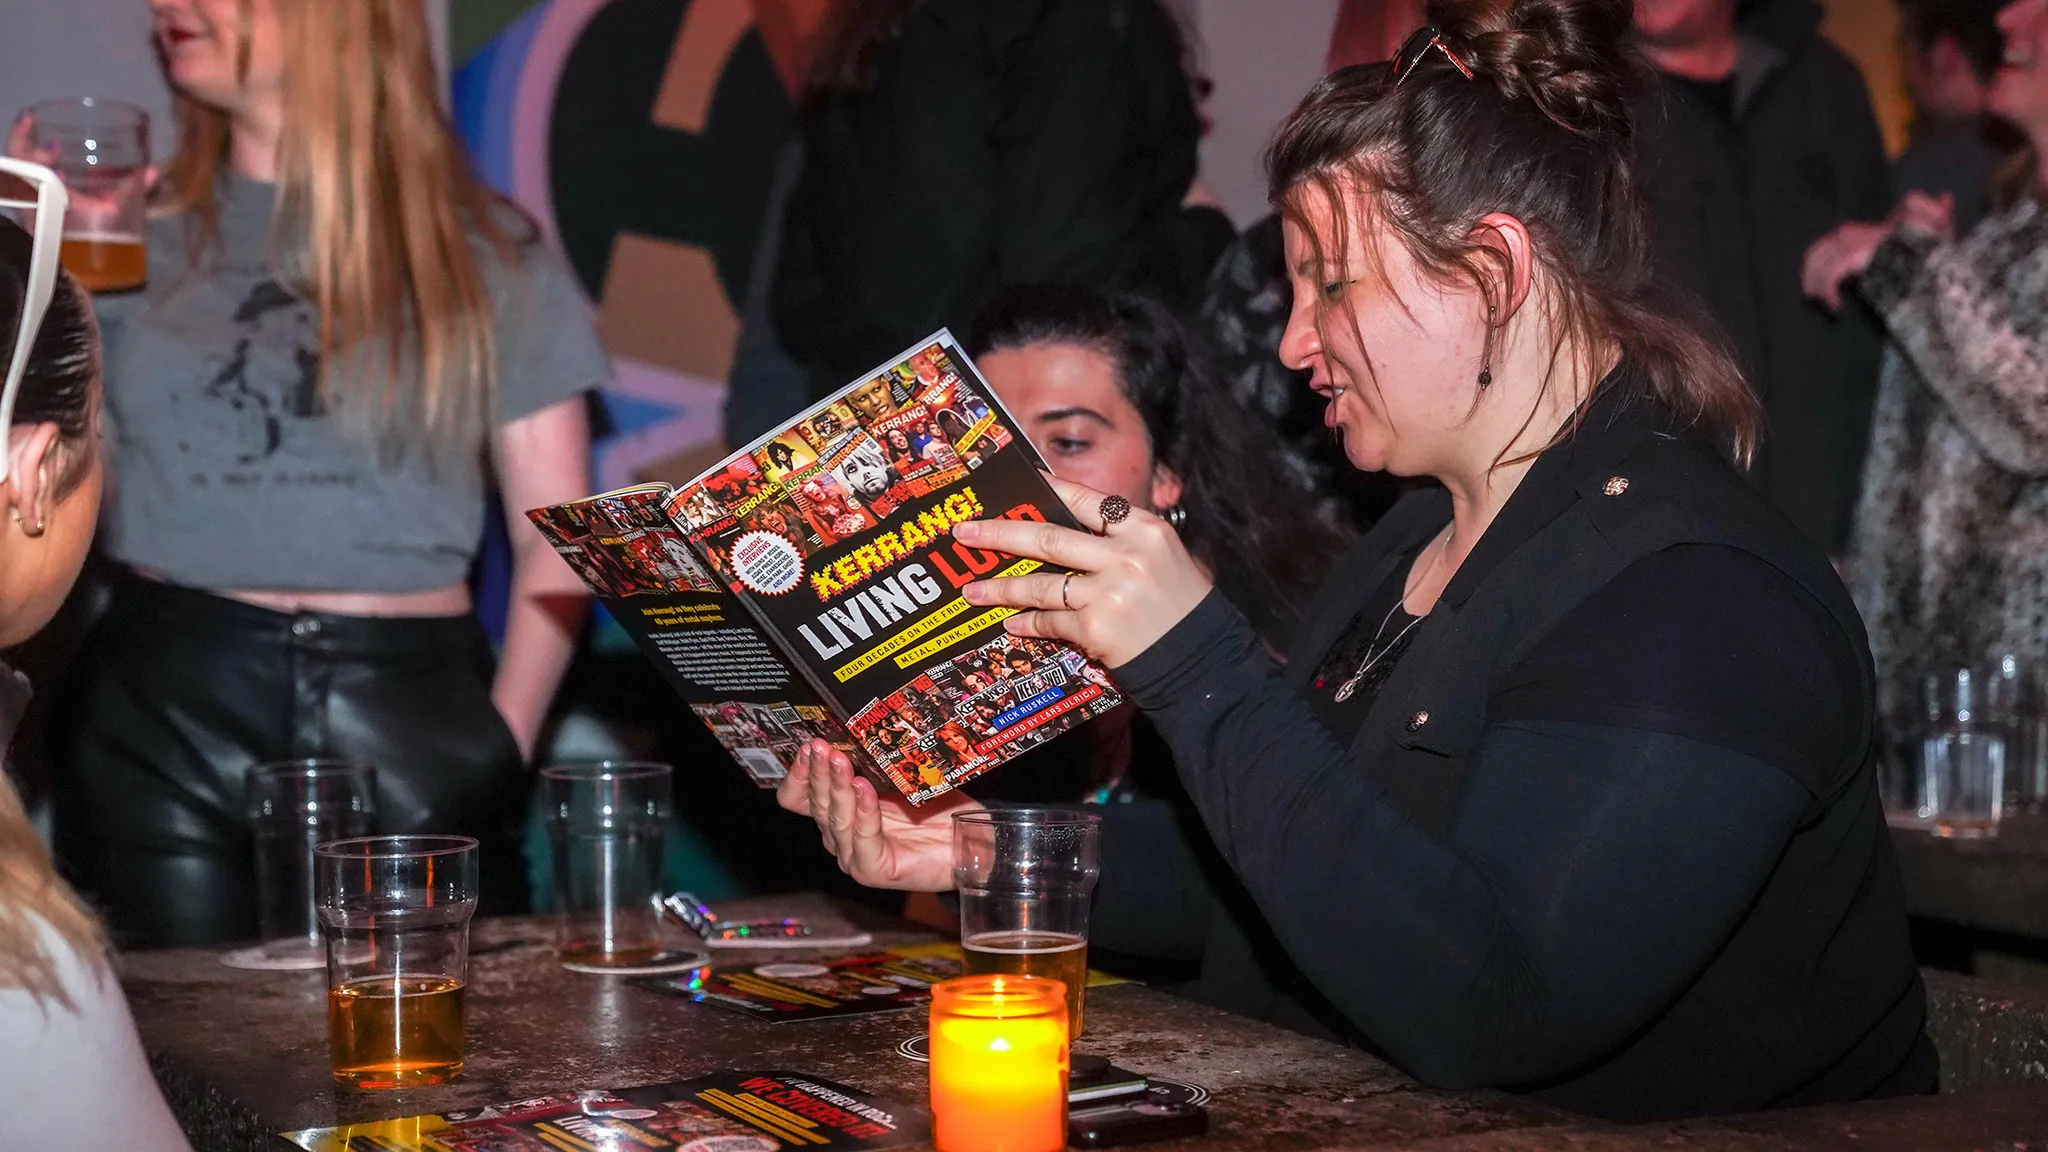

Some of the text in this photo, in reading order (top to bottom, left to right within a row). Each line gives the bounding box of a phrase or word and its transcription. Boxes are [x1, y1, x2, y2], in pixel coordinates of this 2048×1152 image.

[872, 405, 928, 437] KERRANG!
[785, 464, 825, 491] KERRAN
[733, 481, 781, 518] KERRANG!
[737, 536, 764, 560] EXCLUSIVE
[742, 541, 771, 567] INTERVIEWS
[809, 486, 984, 603] KERRANG!
[797, 563, 942, 661] LIVING
[928, 503, 1048, 589] LO
[968, 616, 988, 632] AND
[990, 605, 1020, 623] ALTE
[840, 600, 967, 678] FOUR DECADES ON THE FRON
[980, 688, 1096, 752] FOREWORD BY LARS ULRICH
[998, 690, 1060, 726] NICK RUSKELL
[944, 754, 990, 782] PARAMORE
[738, 1076, 785, 1096] WE
